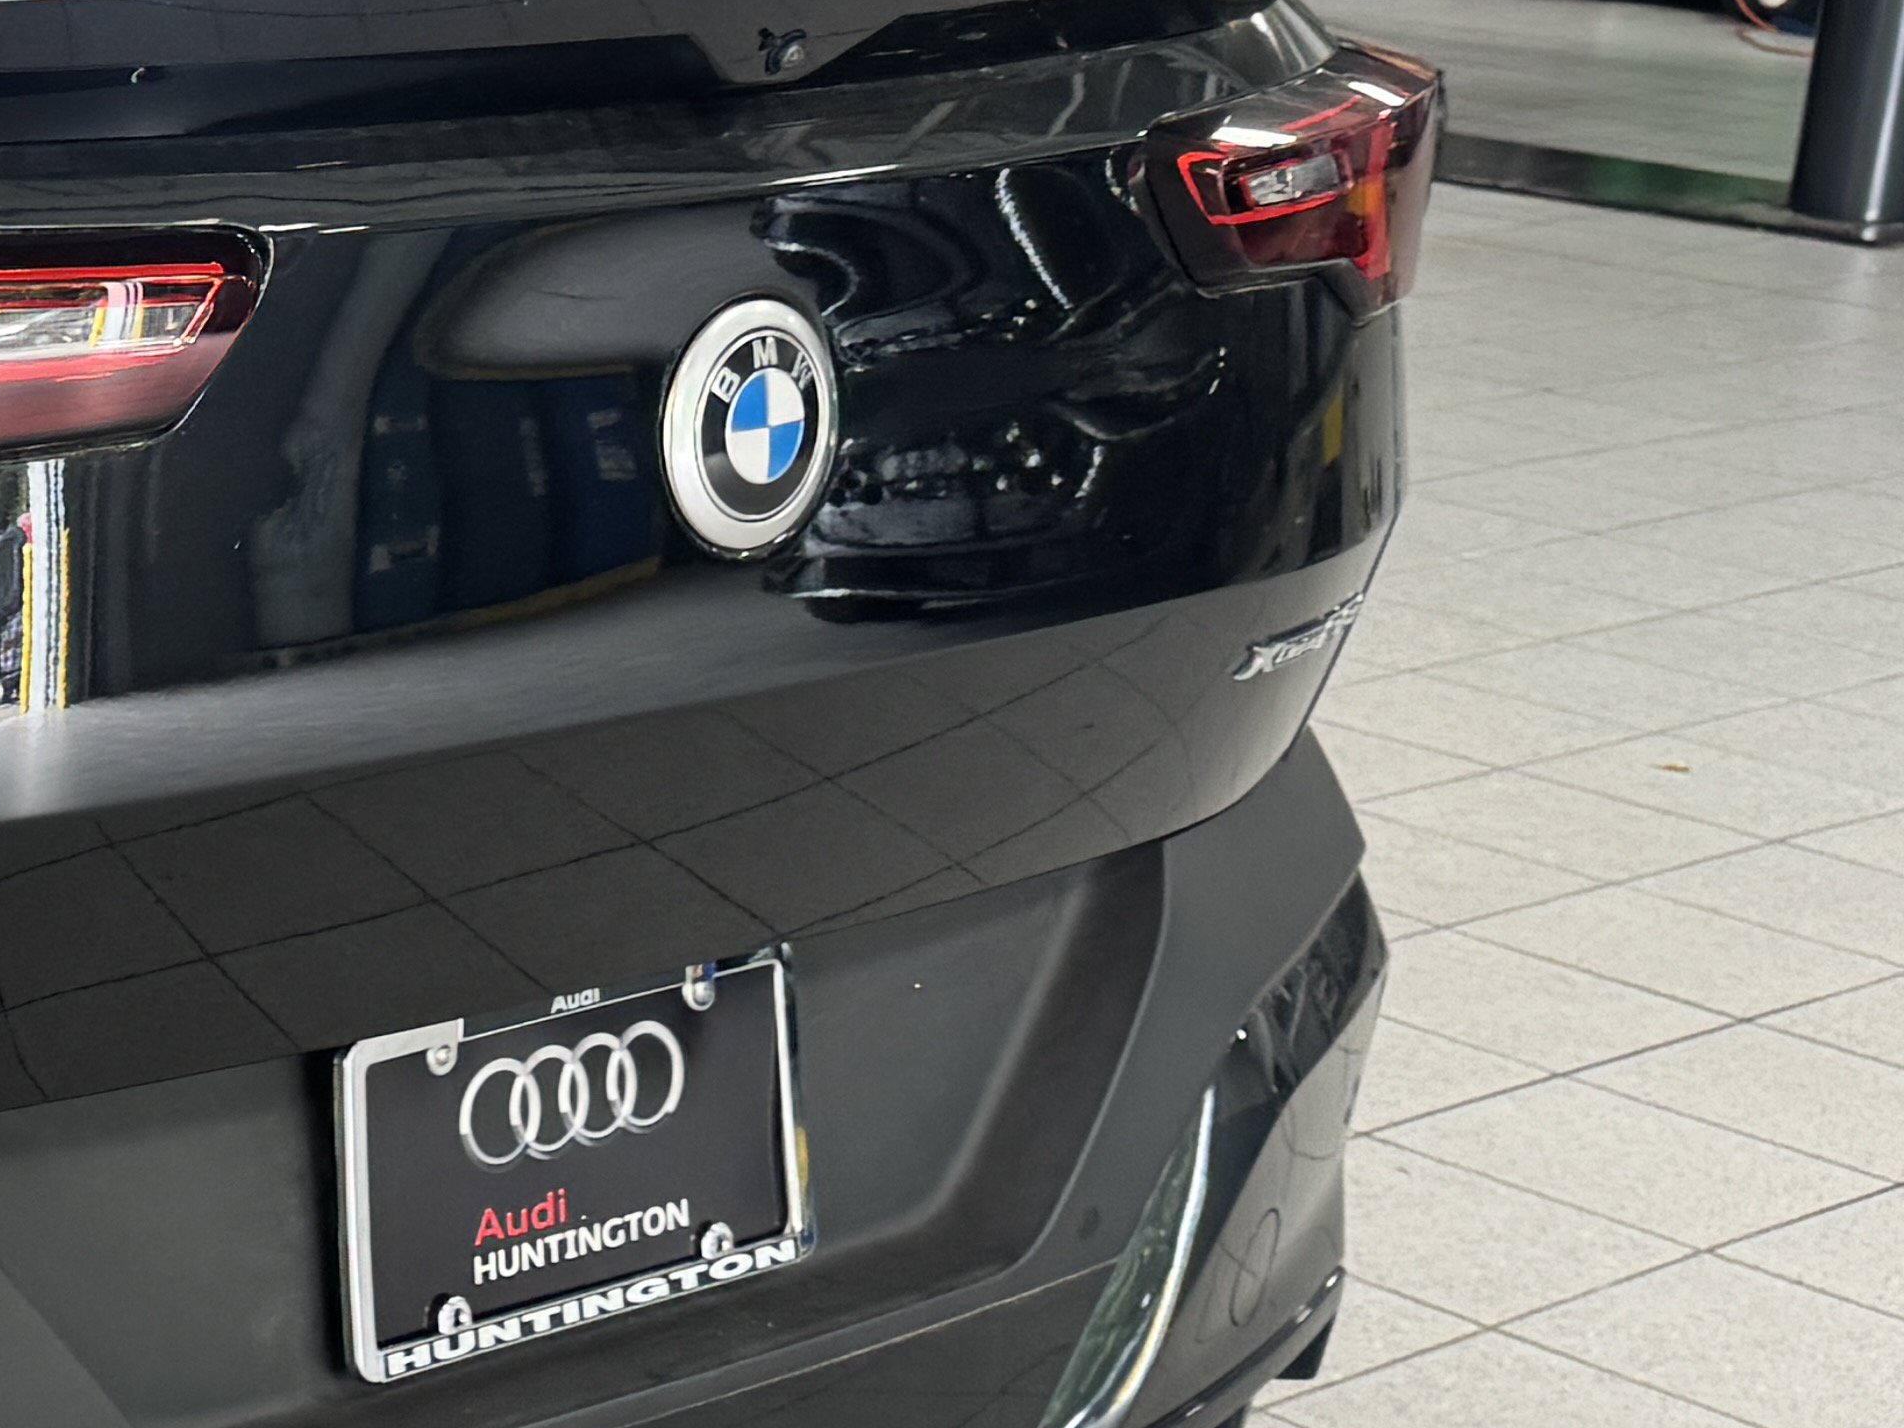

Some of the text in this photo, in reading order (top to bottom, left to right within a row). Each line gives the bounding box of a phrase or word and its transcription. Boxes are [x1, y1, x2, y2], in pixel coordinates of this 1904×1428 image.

[710, 336, 814, 404] BMW
[473, 1189, 567, 1247] Audi
[473, 1198, 690, 1285] HUNTINGTON
[386, 1239, 800, 1379] HUNTINGTON
